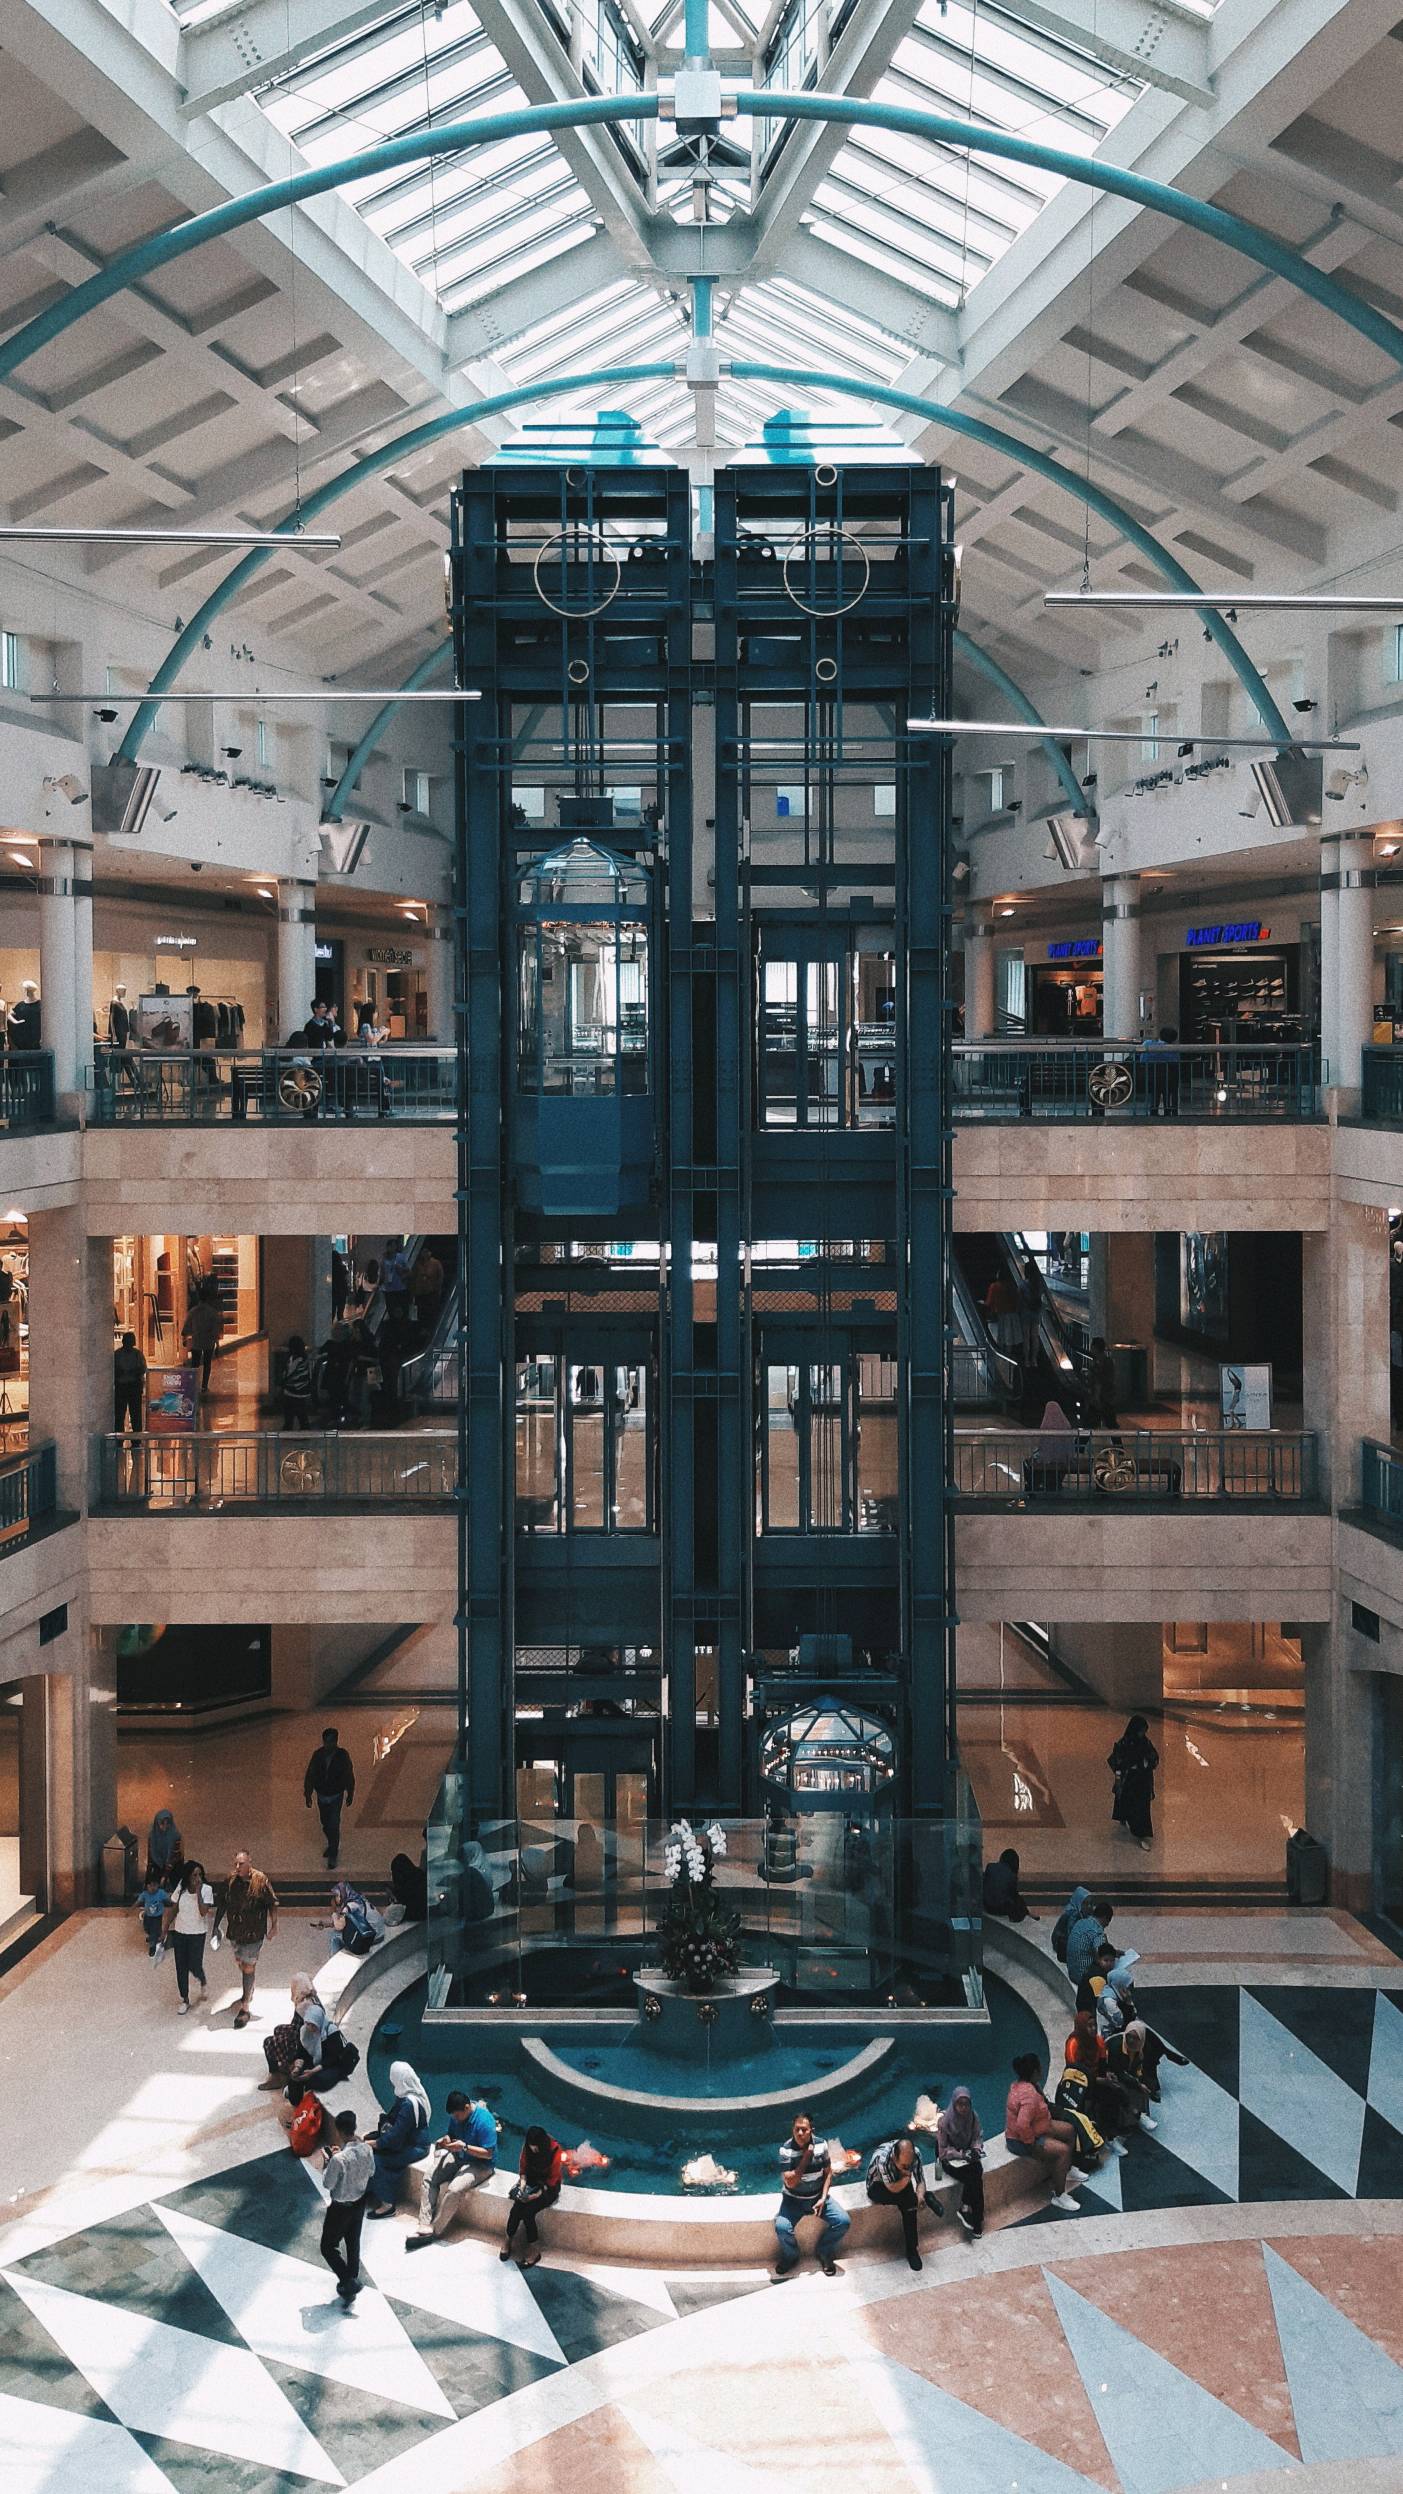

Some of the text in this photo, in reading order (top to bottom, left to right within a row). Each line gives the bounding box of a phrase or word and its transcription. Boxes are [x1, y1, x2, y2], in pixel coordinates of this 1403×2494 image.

[1185, 927, 1221, 946] PLANET
[1222, 921, 1261, 944] SPORTS
[1072, 940, 1098, 957] SPORTS
